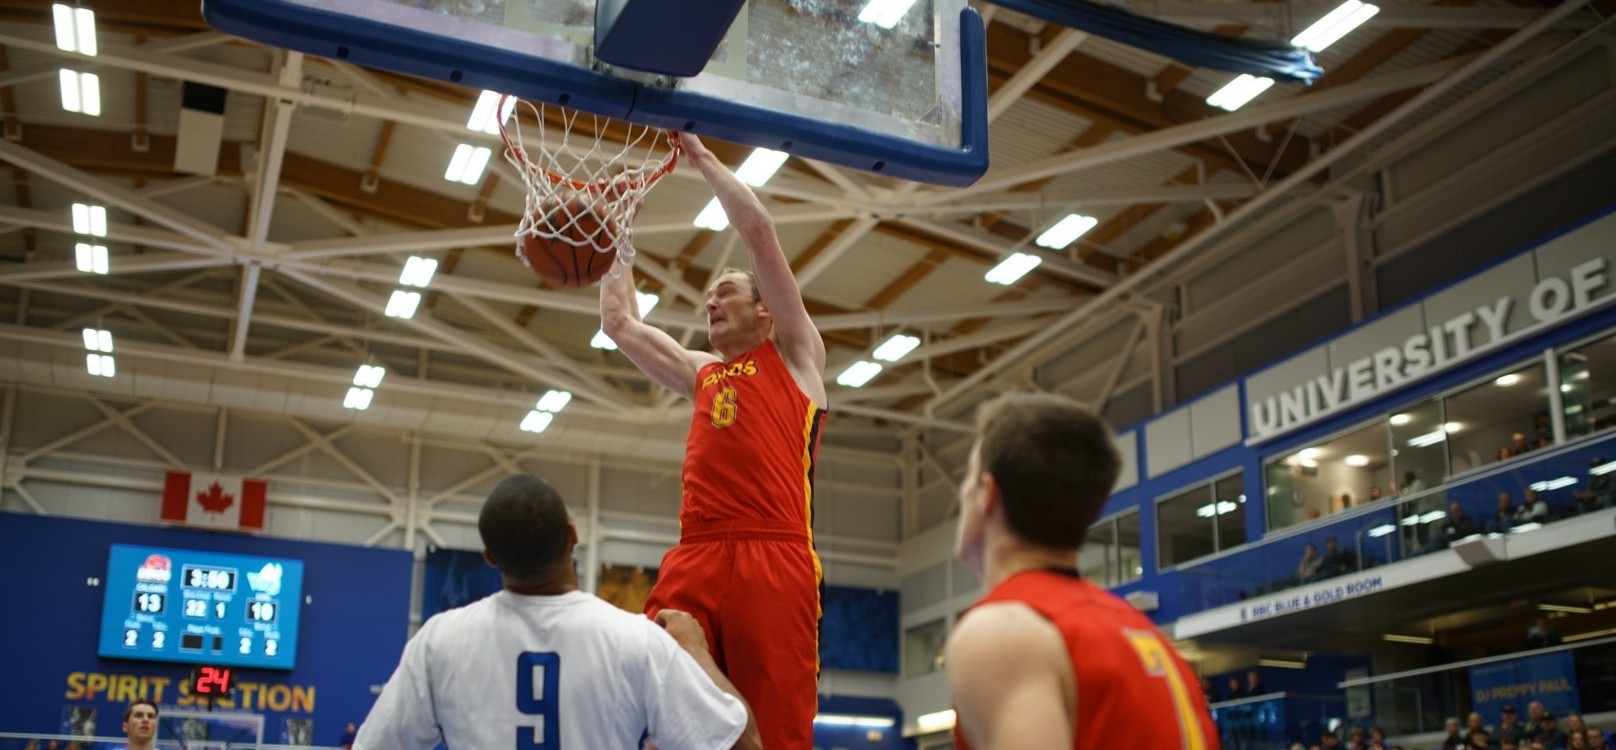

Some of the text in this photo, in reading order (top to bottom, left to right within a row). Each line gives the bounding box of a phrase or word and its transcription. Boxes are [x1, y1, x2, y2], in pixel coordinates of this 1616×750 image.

[1252, 257, 1606, 437] UNIVERSITY OF
[711, 386, 737, 429] 6
[138, 593, 162, 613] 13
[1275, 598, 1300, 612] BLUE
[1313, 586, 1344, 603] GOLD
[1346, 576, 1383, 594] ROOM
[186, 600, 207, 617] 22
[215, 602, 226, 619] 1
[251, 602, 274, 621] 10
[125, 629, 138, 646] 2
[153, 631, 165, 648] 2
[265, 639, 278, 656] 2
[65, 671, 171, 704] SPIRIT
[197, 667, 230, 693] 24
[1120, 626, 1207, 750] 7
[516, 651, 561, 750] 9
